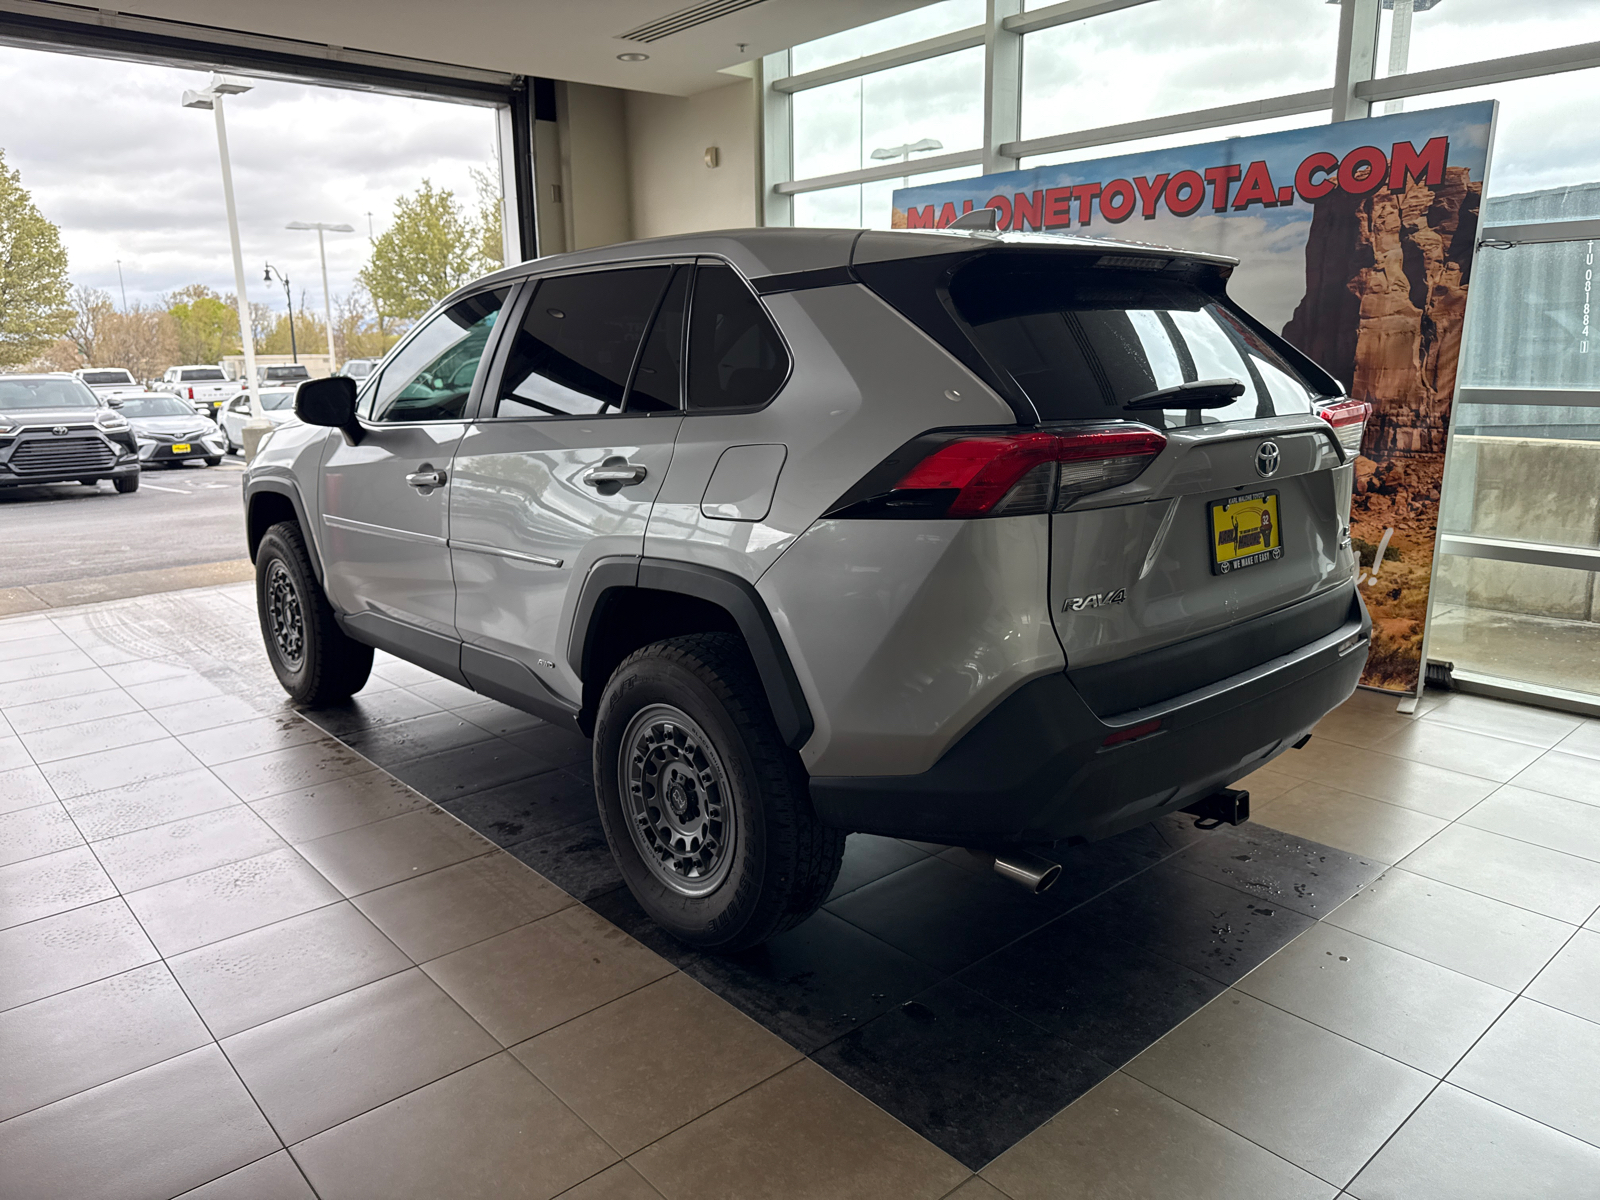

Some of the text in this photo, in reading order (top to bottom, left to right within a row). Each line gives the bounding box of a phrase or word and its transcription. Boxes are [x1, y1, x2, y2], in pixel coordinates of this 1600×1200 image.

[1586, 240, 1594, 265] TU
[1262, 515, 1269, 525] 32
[1233, 560, 1241, 570] WE
[1241, 556, 1254, 566] MAKE
[1259, 552, 1270, 562] EASY
[1061, 587, 1127, 613] RAV4
